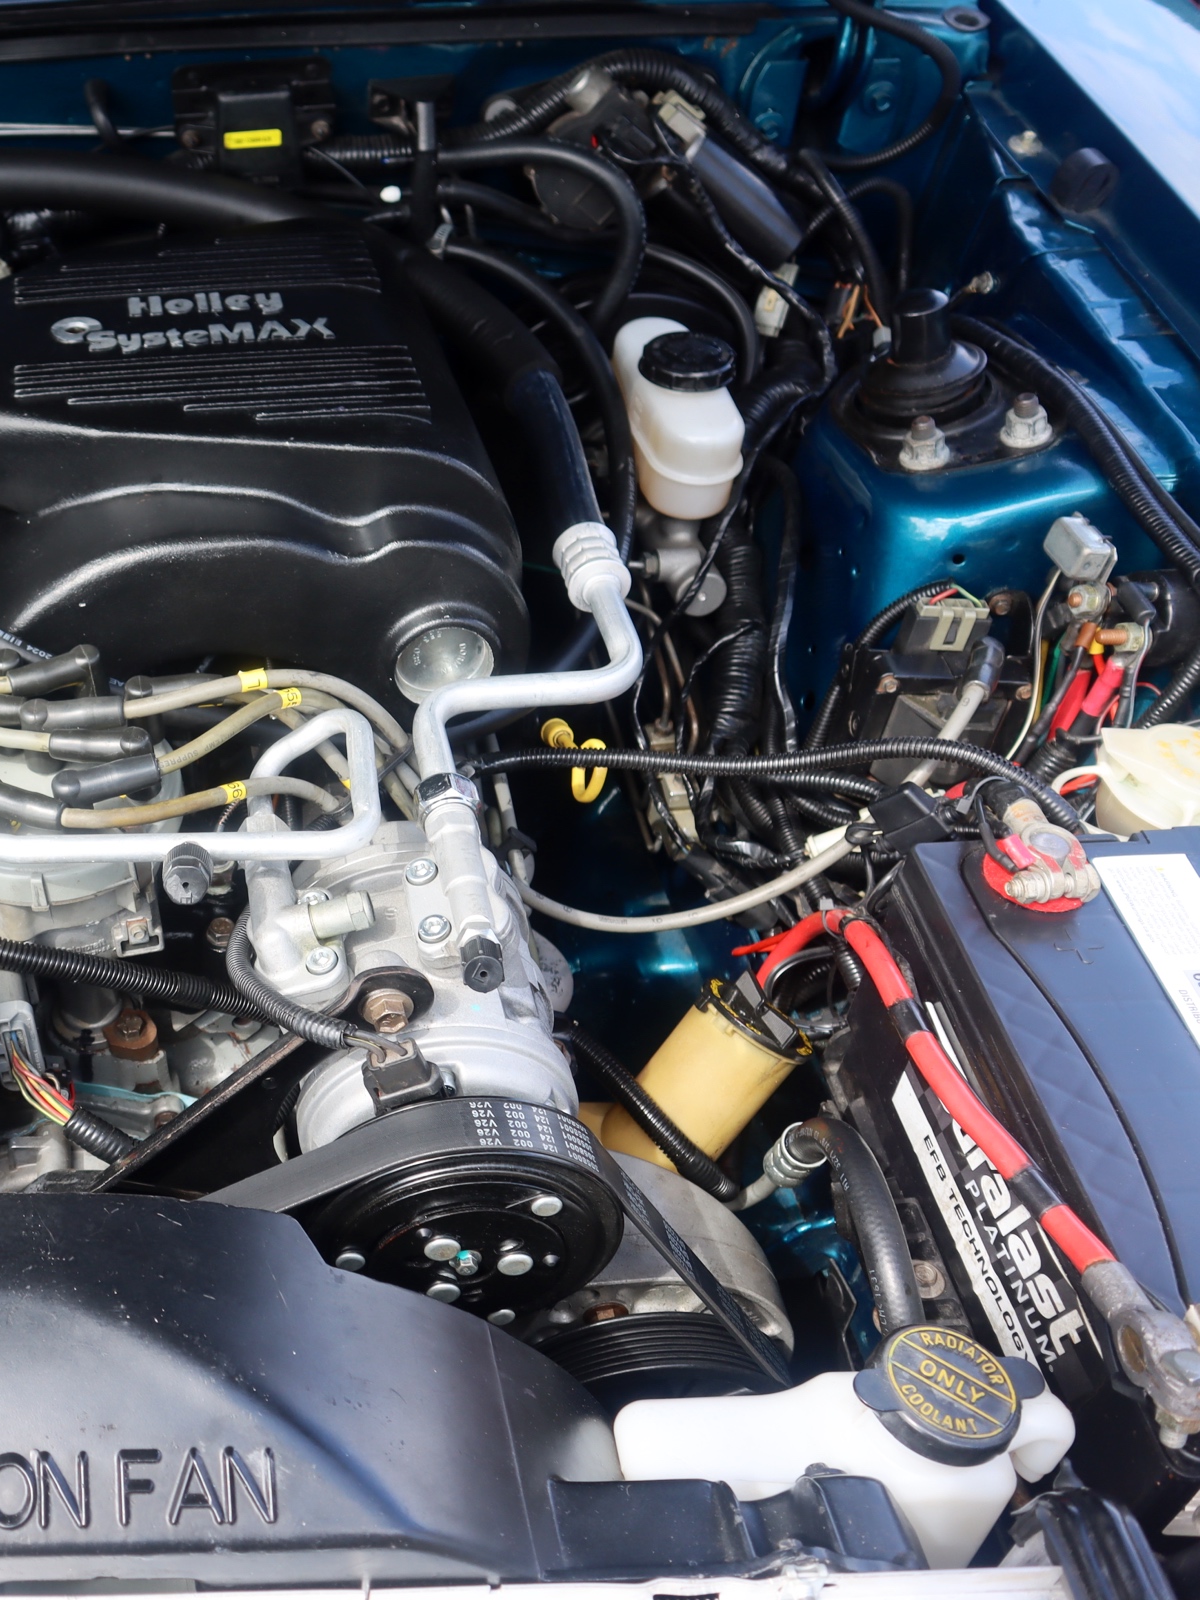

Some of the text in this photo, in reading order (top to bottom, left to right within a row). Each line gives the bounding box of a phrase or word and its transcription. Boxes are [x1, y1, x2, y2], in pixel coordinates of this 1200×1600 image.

[127, 292, 284, 317] Holley
[86, 317, 336, 355] SysteMAX
[472, 1109, 495, 1118] V26
[505, 1110, 525, 1120] 002
[474, 1119, 497, 1128] V26
[507, 1119, 528, 1130] 002
[476, 1128, 500, 1137] V26
[510, 1129, 531, 1139] 002
[479, 1137, 503, 1146] V26
[513, 1138, 534, 1149] 002
[923, 1134, 947, 1182] EFB
[919, 1331, 1005, 1385] RADIATOR
[919, 1359, 986, 1404] ONLY
[902, 1384, 977, 1434] COOLANT
[116, 1447, 277, 1526] FAN
